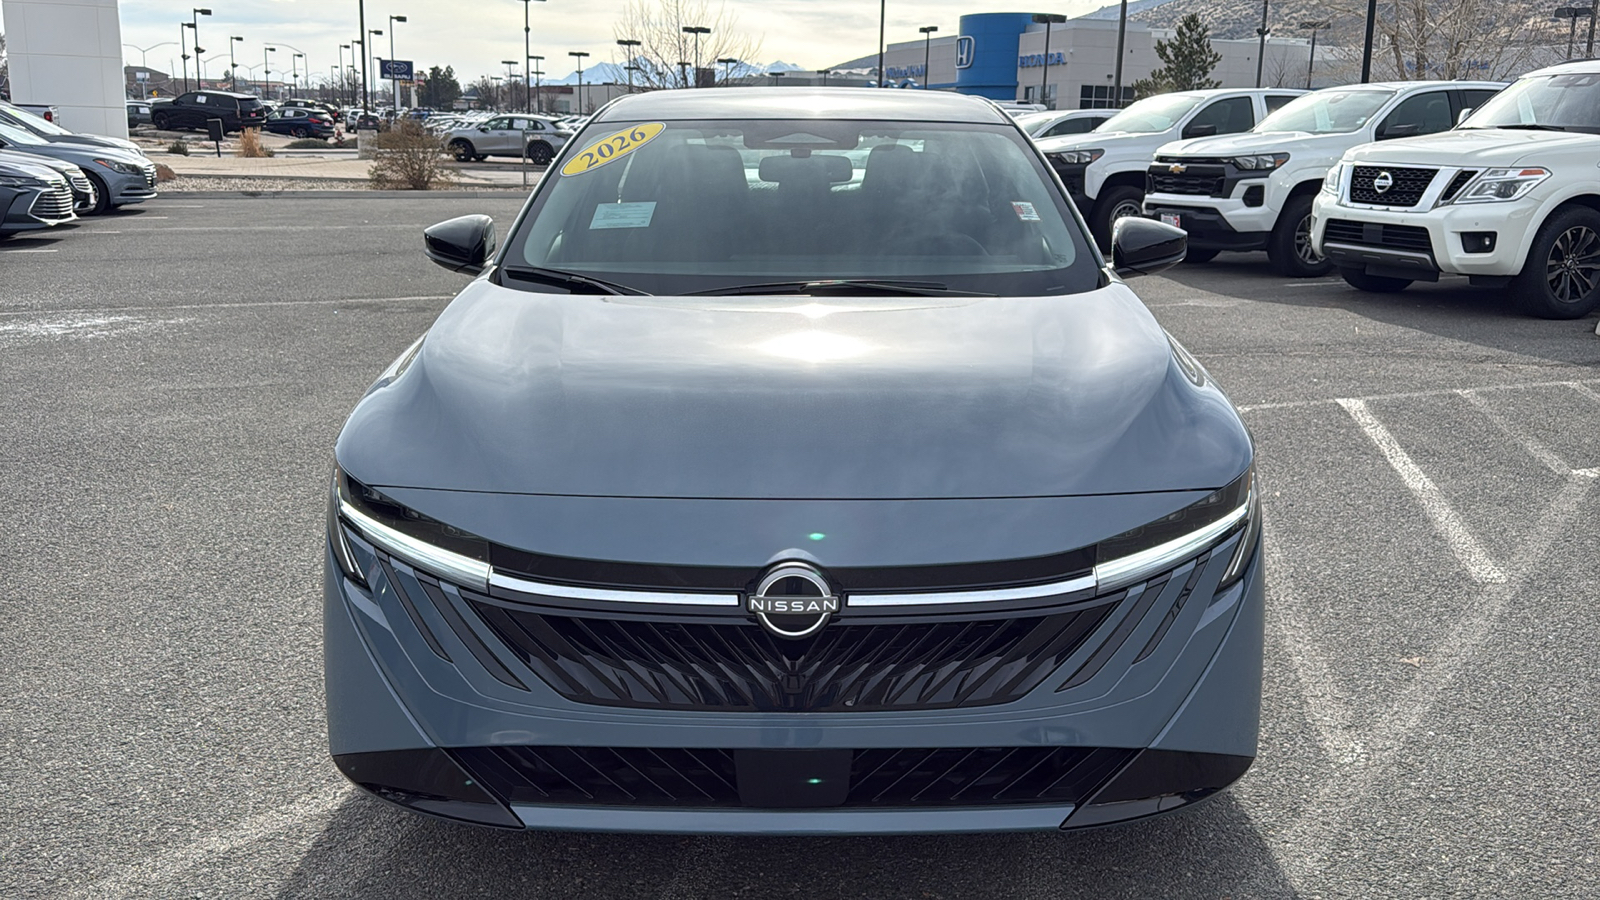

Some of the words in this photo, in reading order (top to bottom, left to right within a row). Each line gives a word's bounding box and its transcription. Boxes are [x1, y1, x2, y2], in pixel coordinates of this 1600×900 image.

[1019, 52, 1066, 67] HONDA
[580, 127, 646, 169] 2026
[751, 599, 837, 612] NISSAN
